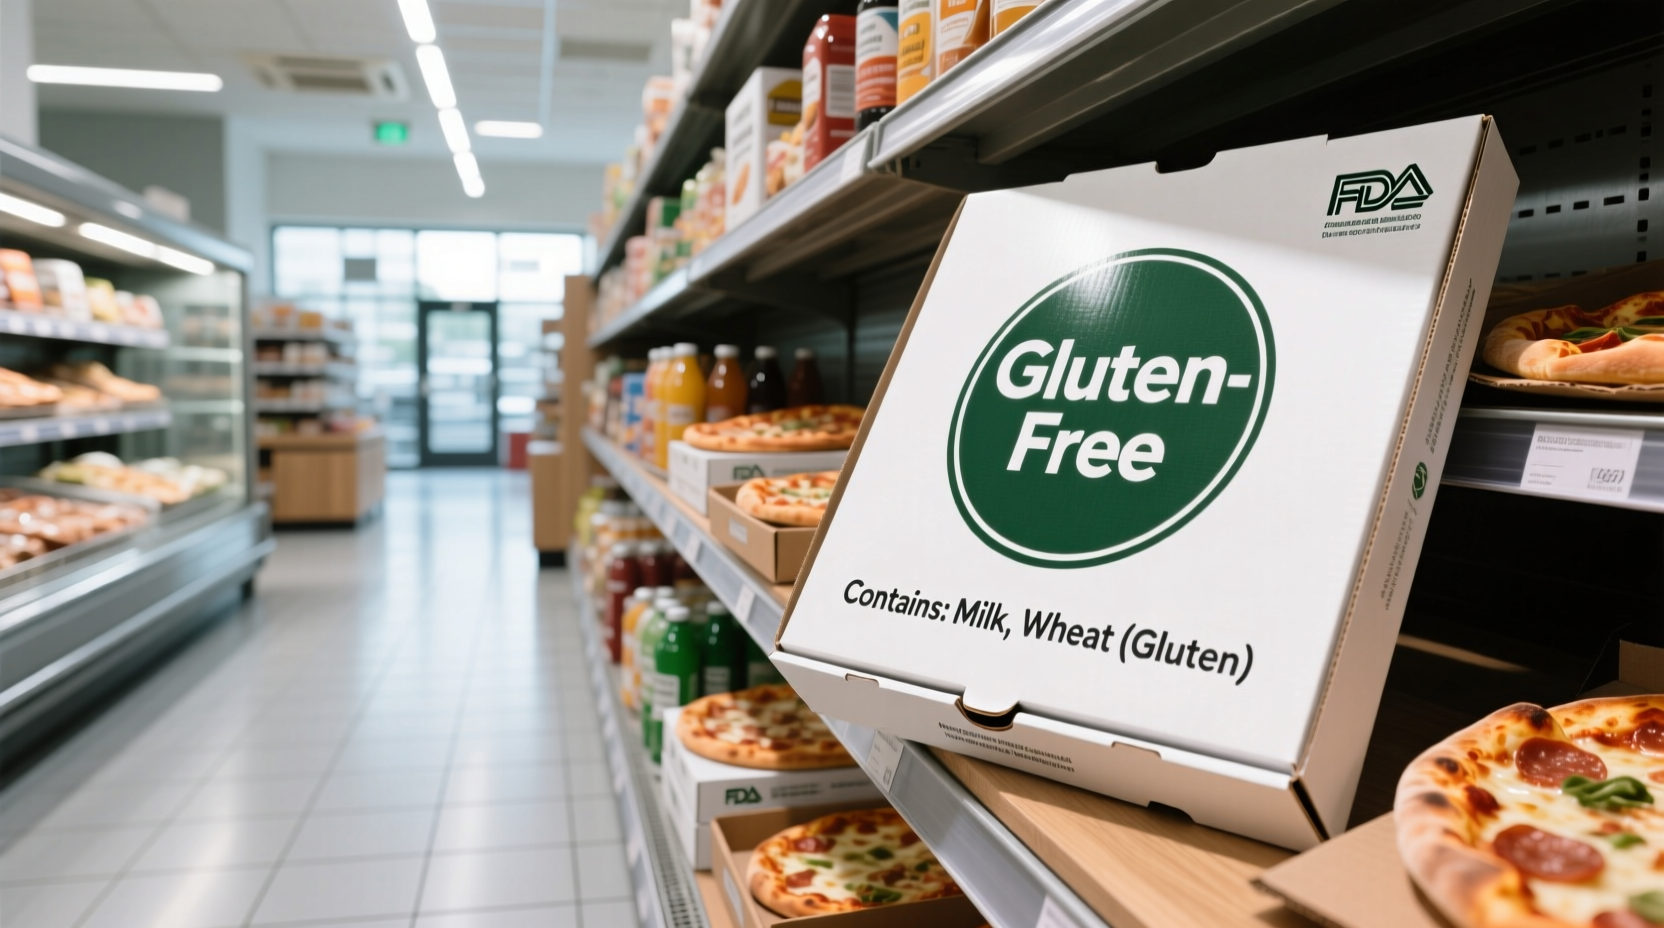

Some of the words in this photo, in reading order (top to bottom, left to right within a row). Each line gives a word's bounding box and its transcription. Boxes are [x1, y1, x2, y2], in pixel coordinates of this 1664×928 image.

[1326, 163, 1434, 216] FDA
[996, 338, 1252, 404] Gluten-
[1006, 411, 1165, 482] Free
[843, 579, 951, 622] Contains:
[952, 597, 1012, 641] Milk,
[1023, 608, 1115, 653] Wheat
[1119, 623, 1254, 686] (Gluten)
[724, 785, 763, 806] FDA
